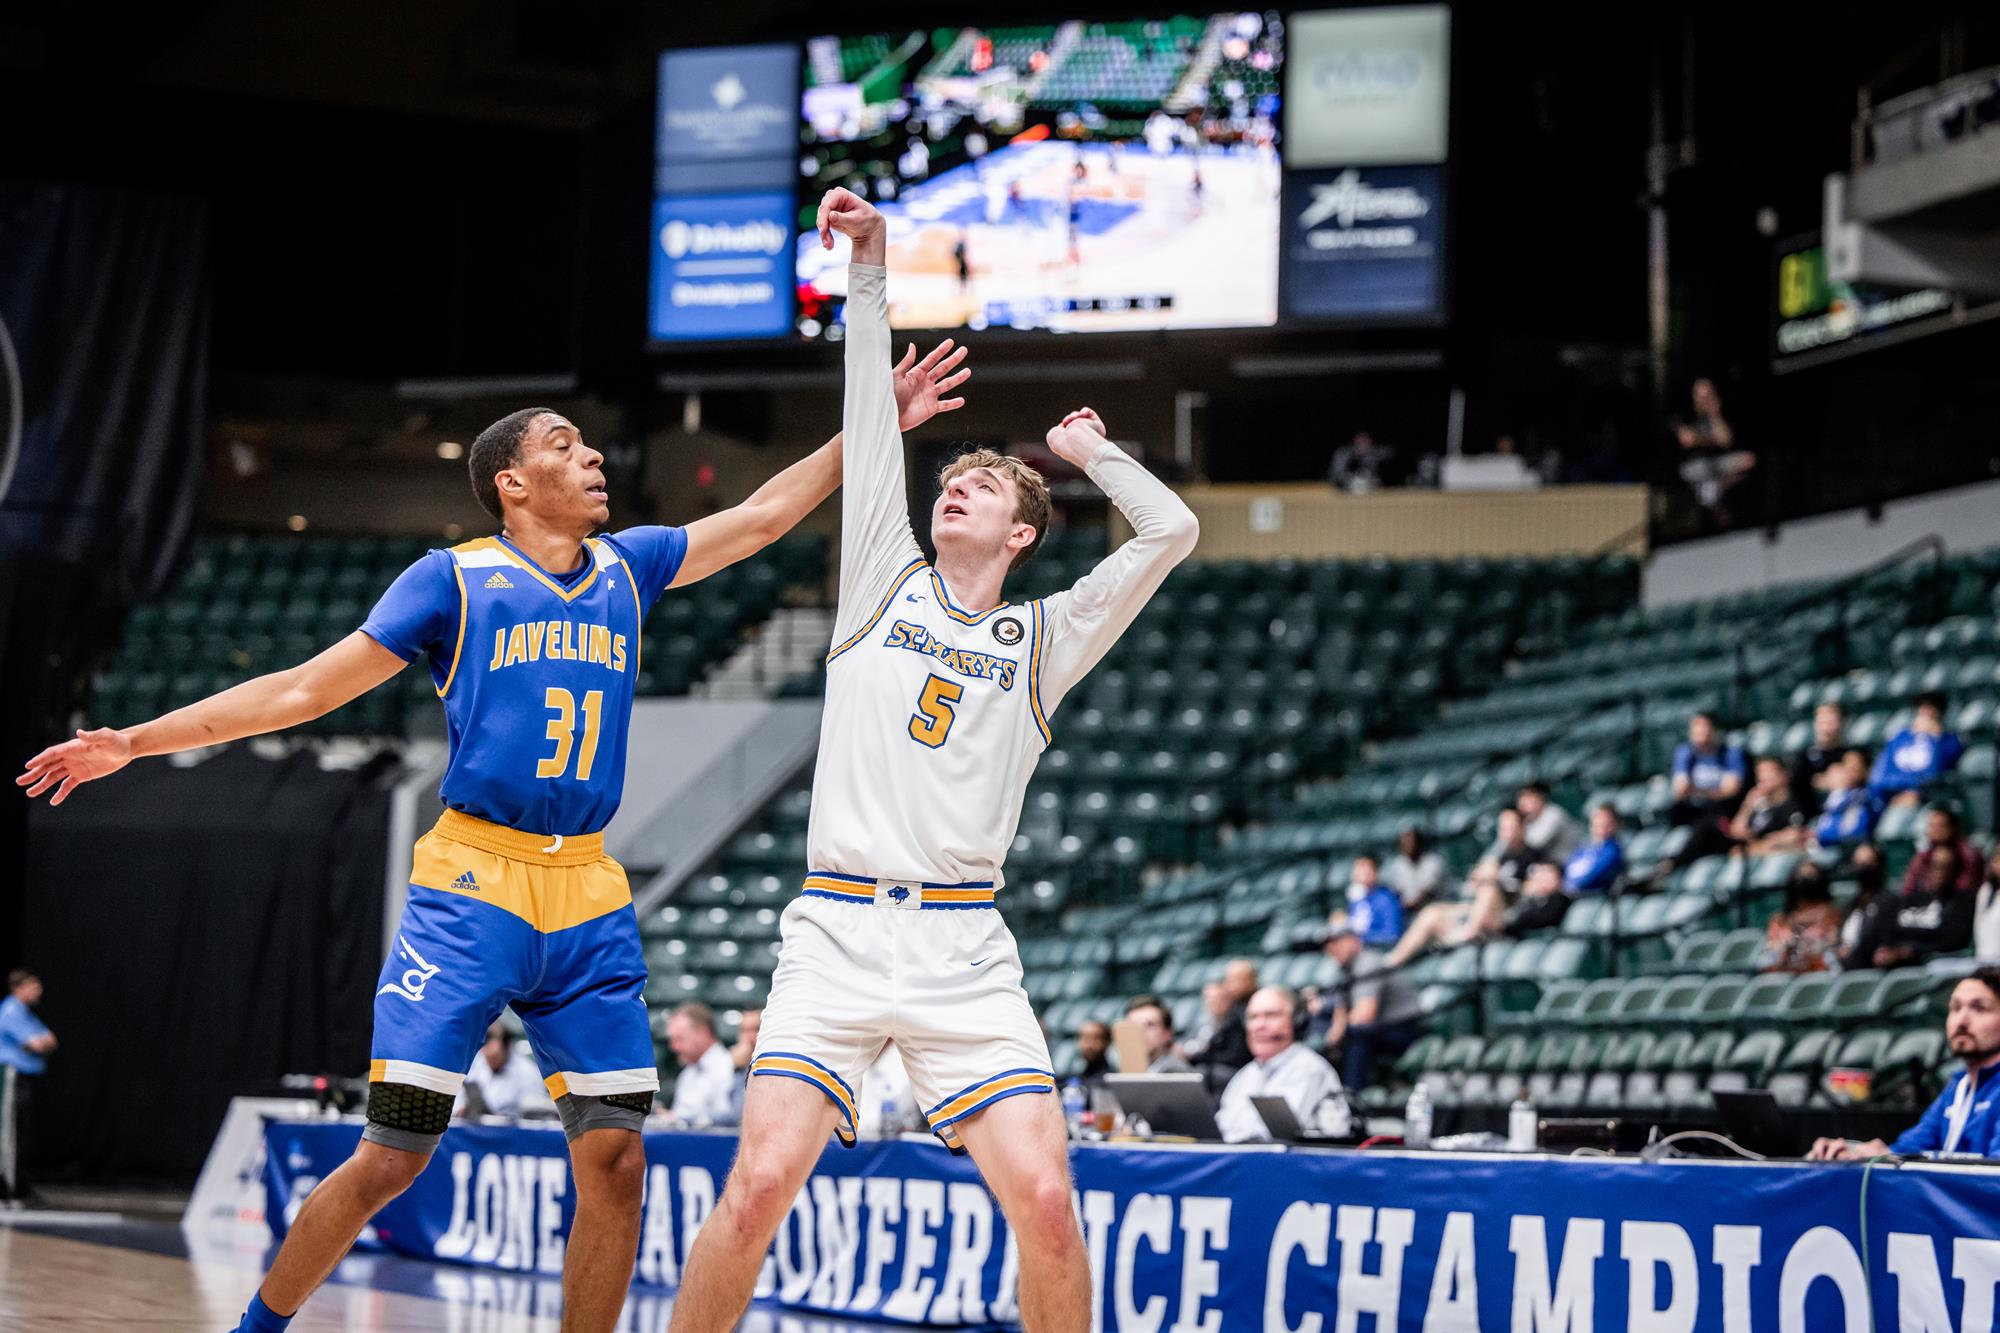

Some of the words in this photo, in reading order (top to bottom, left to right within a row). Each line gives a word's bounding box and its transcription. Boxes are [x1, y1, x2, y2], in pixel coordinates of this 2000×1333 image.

[489, 620, 627, 673] JAVELINS
[536, 687, 604, 781] 31
[908, 672, 965, 750] 5
[450, 881, 480, 891] adidas
[433, 1151, 567, 1273] LONE
